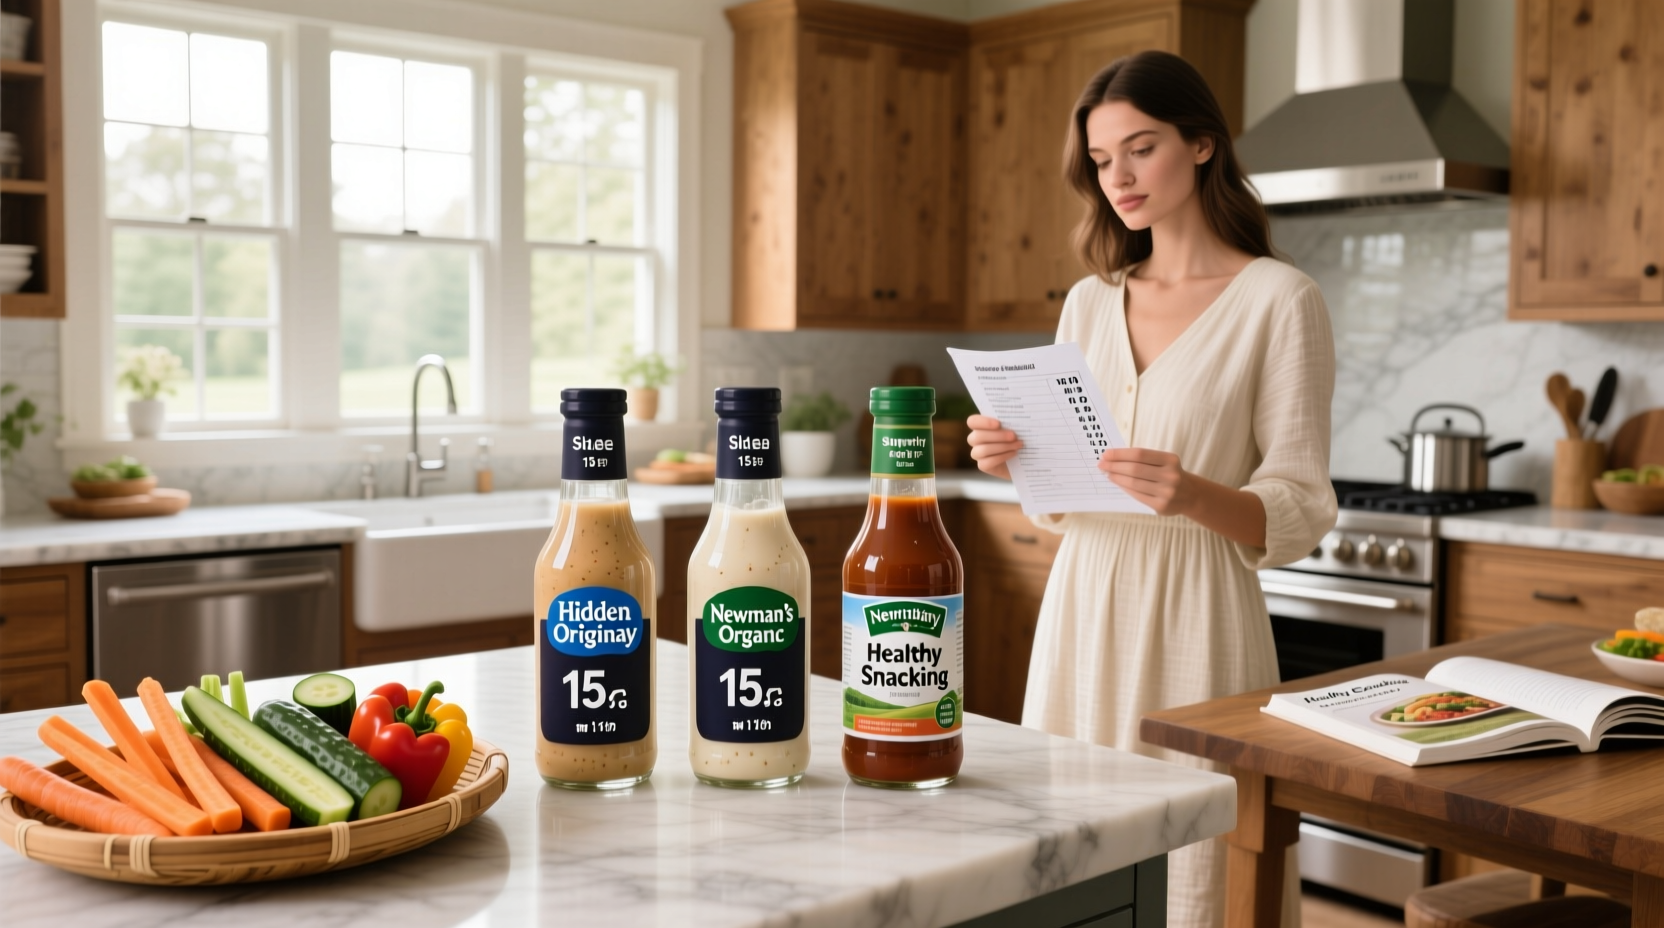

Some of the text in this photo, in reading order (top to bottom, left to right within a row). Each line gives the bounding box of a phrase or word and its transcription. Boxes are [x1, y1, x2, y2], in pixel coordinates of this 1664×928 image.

[558, 600, 632, 622] Hidden
[710, 602, 794, 624] Newman's
[552, 622, 638, 650] Originay
[718, 624, 785, 649] Organc
[867, 642, 943, 668] Healthy
[861, 664, 949, 691] Snacking
